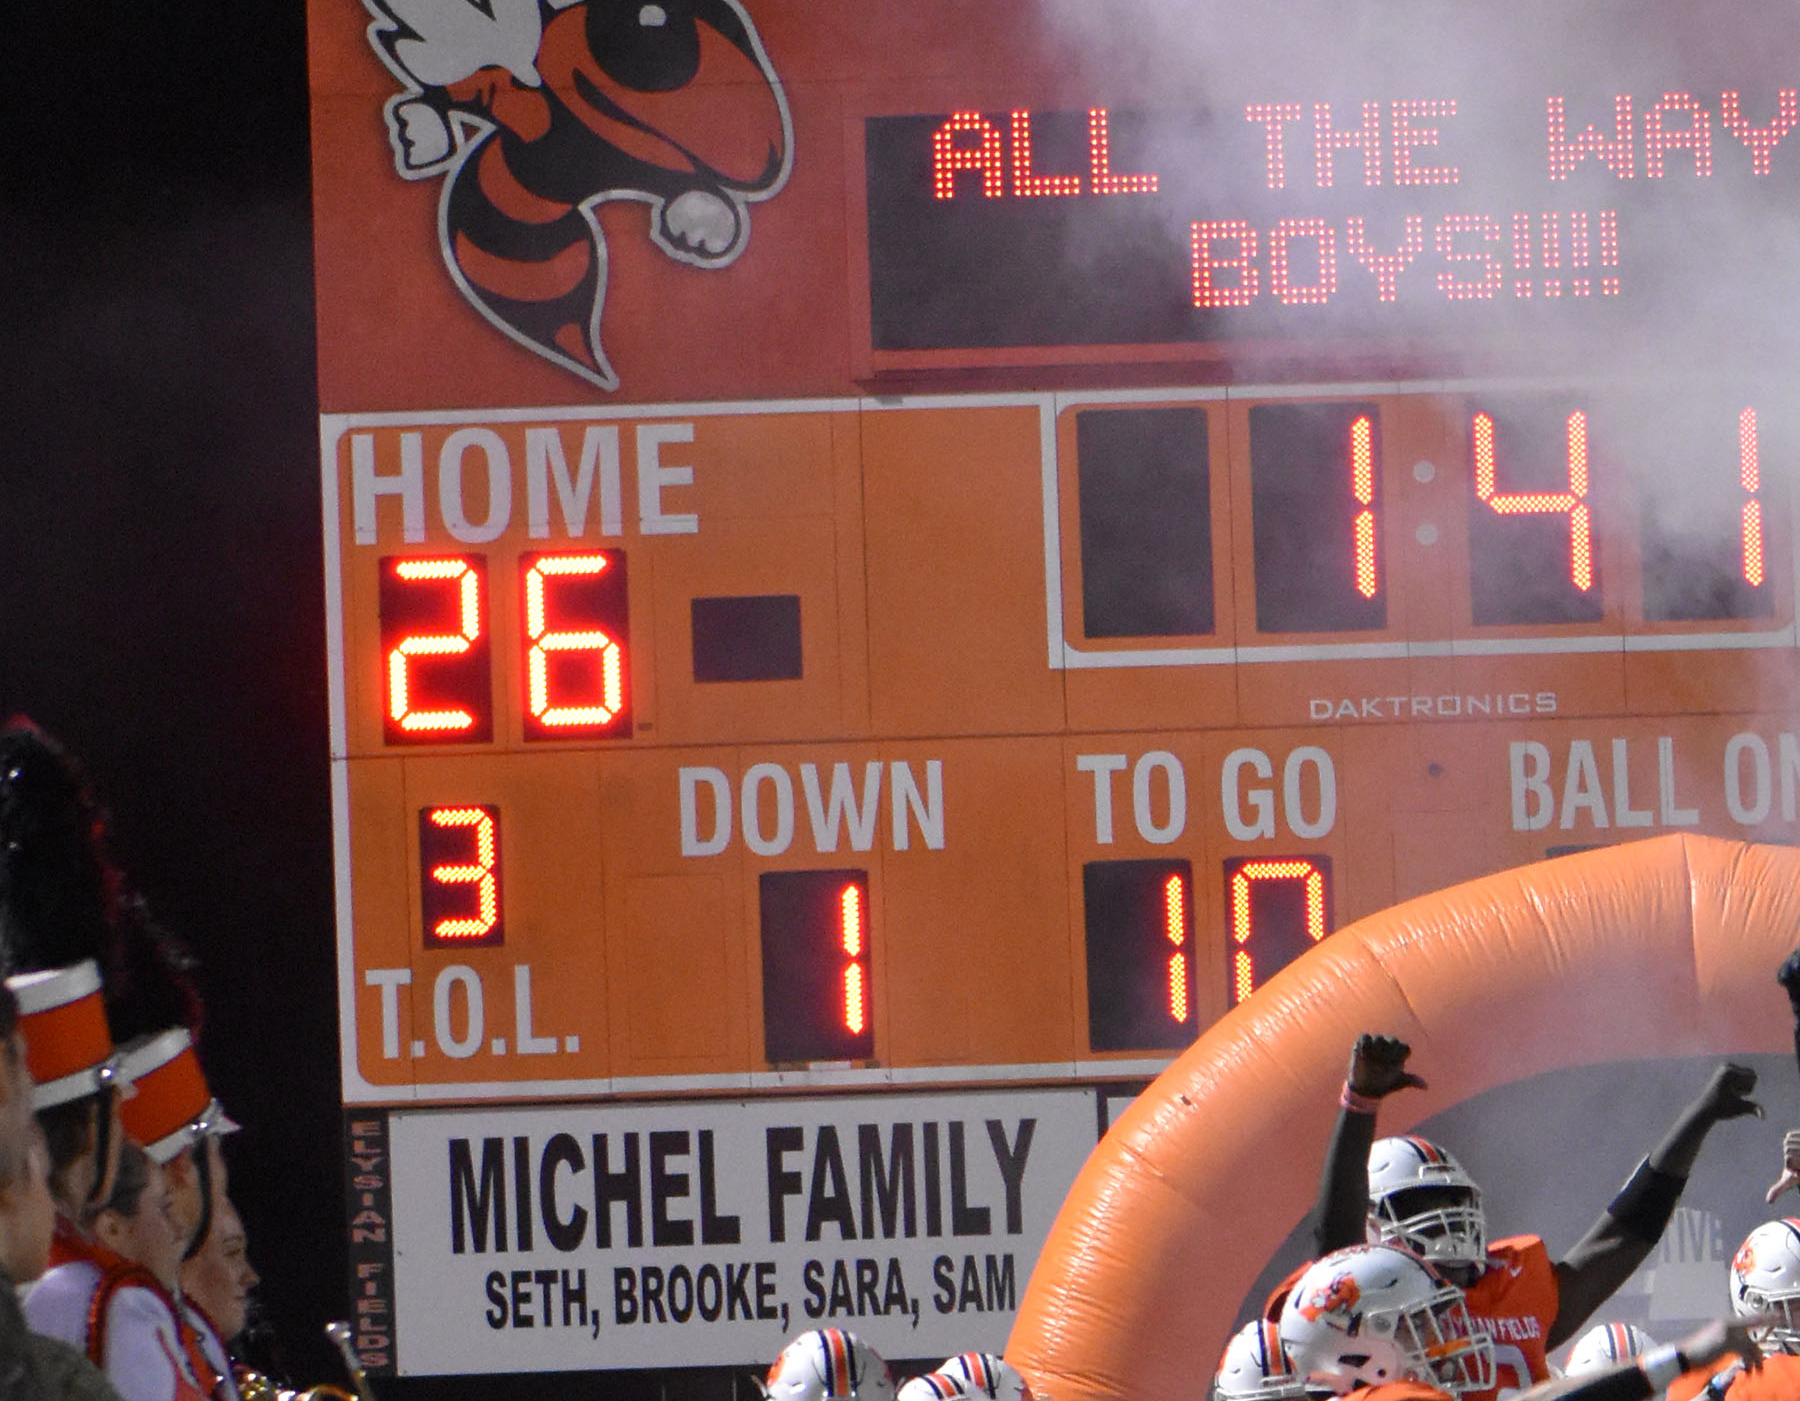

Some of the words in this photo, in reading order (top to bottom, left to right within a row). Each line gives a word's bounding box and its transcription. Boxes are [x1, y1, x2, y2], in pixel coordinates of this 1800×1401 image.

[933, 107, 1159, 199] ALL
[1245, 99, 1460, 190] THE
[1546, 89, 1800, 180] WAY
[1190, 209, 1620, 308] BOYS!!!!
[351, 423, 699, 545] HOME
[388, 555, 622, 732] 26
[1309, 691, 1558, 720] DAKTRONICS
[679, 760, 945, 857] DOWN
[1077, 751, 1187, 844] TO
[1220, 745, 1337, 840] GO
[1508, 735, 1699, 831] BALL
[430, 807, 497, 938] 3
[839, 883, 868, 1035] 1
[365, 964, 580, 1059] T.O.L.
[448, 1127, 741, 1255] MICHEL
[766, 1118, 1036, 1243] FAMILY
[484, 1270, 600, 1339] SETH,
[613, 1262, 789, 1332] BROOKE,
[803, 1258, 919, 1327] SARA,
[932, 1253, 1017, 1314] SAM
